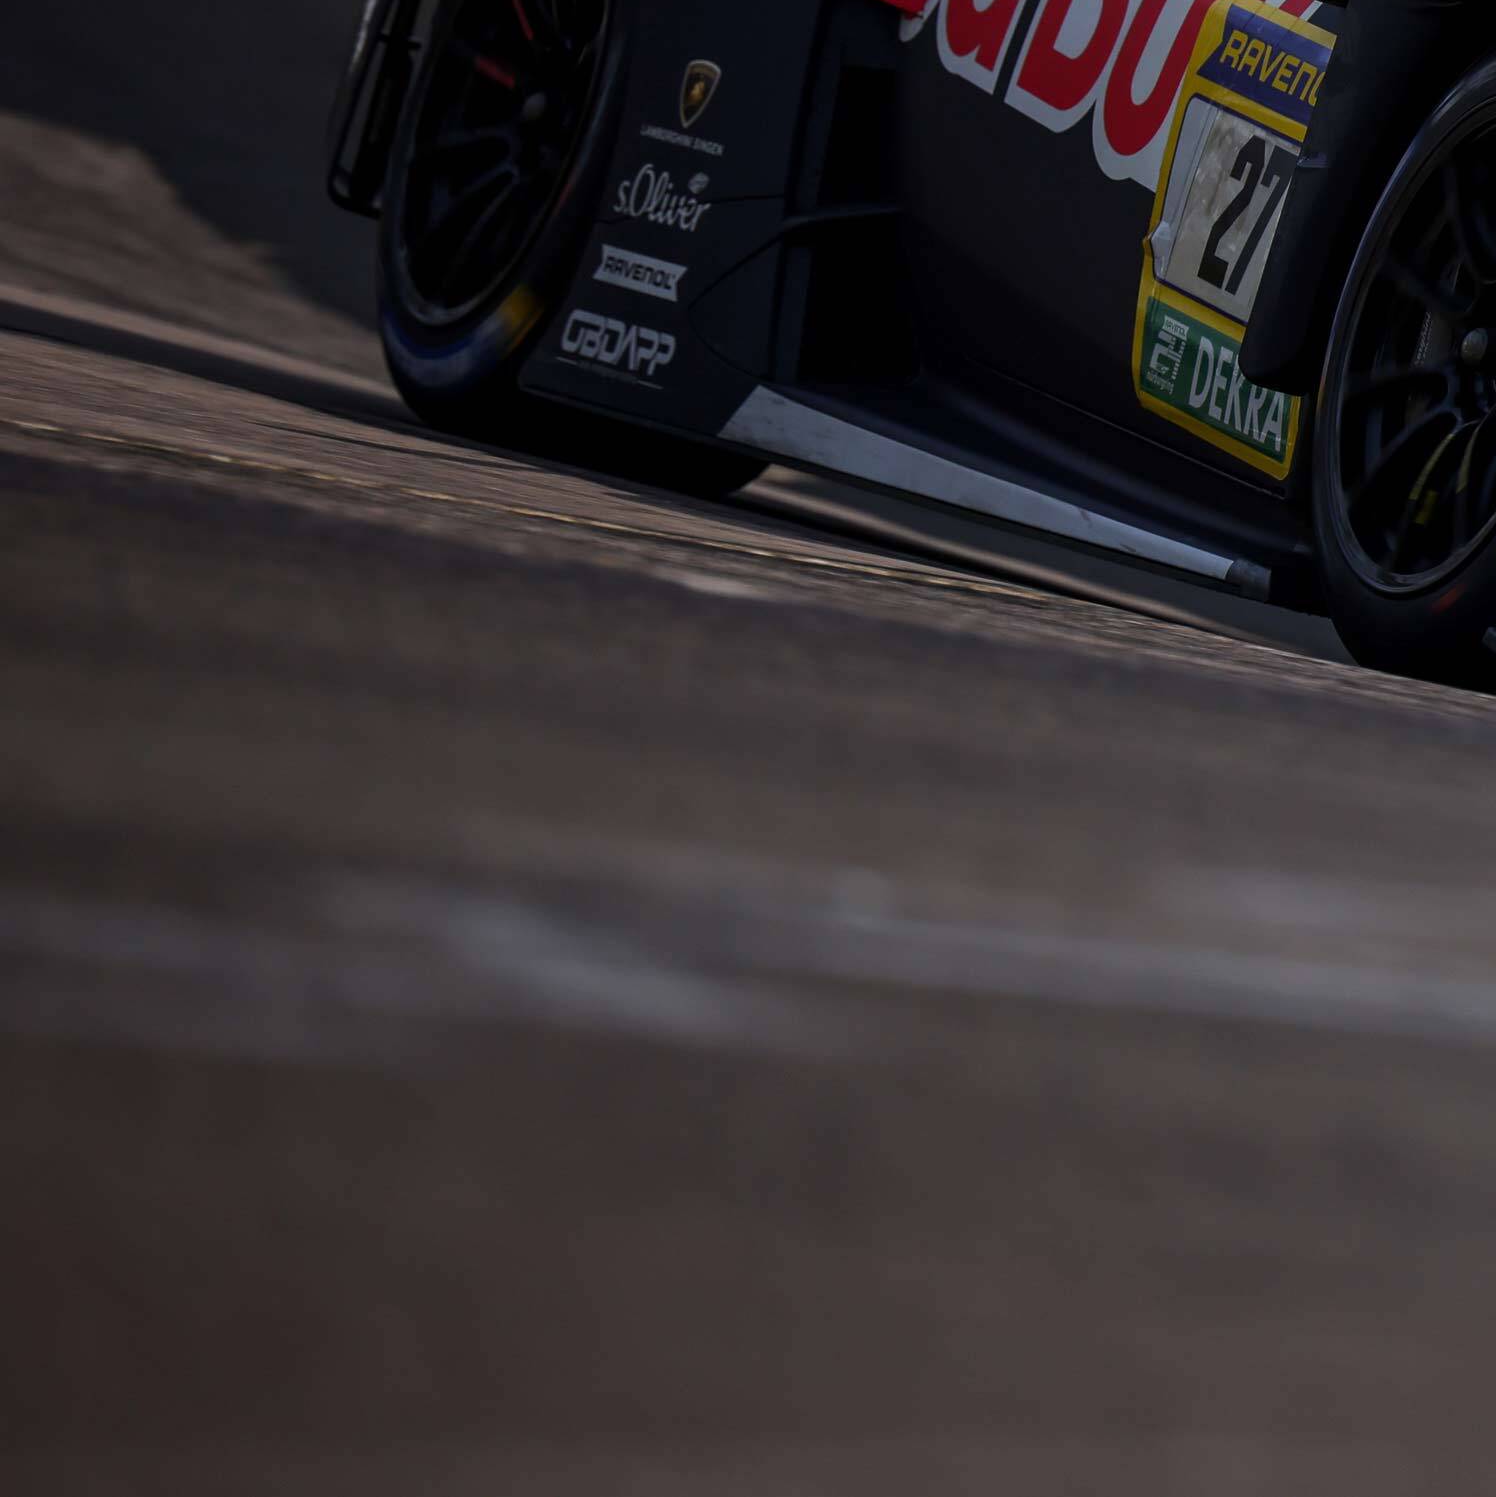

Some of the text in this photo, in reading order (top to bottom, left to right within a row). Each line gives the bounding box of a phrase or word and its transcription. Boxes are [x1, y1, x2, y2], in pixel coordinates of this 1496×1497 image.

[612, 163, 712, 232] s.Oliver
[1197, 134, 1299, 296] 27
[604, 255, 676, 291] RAVENOL
[1188, 335, 1286, 453] DEKRA
